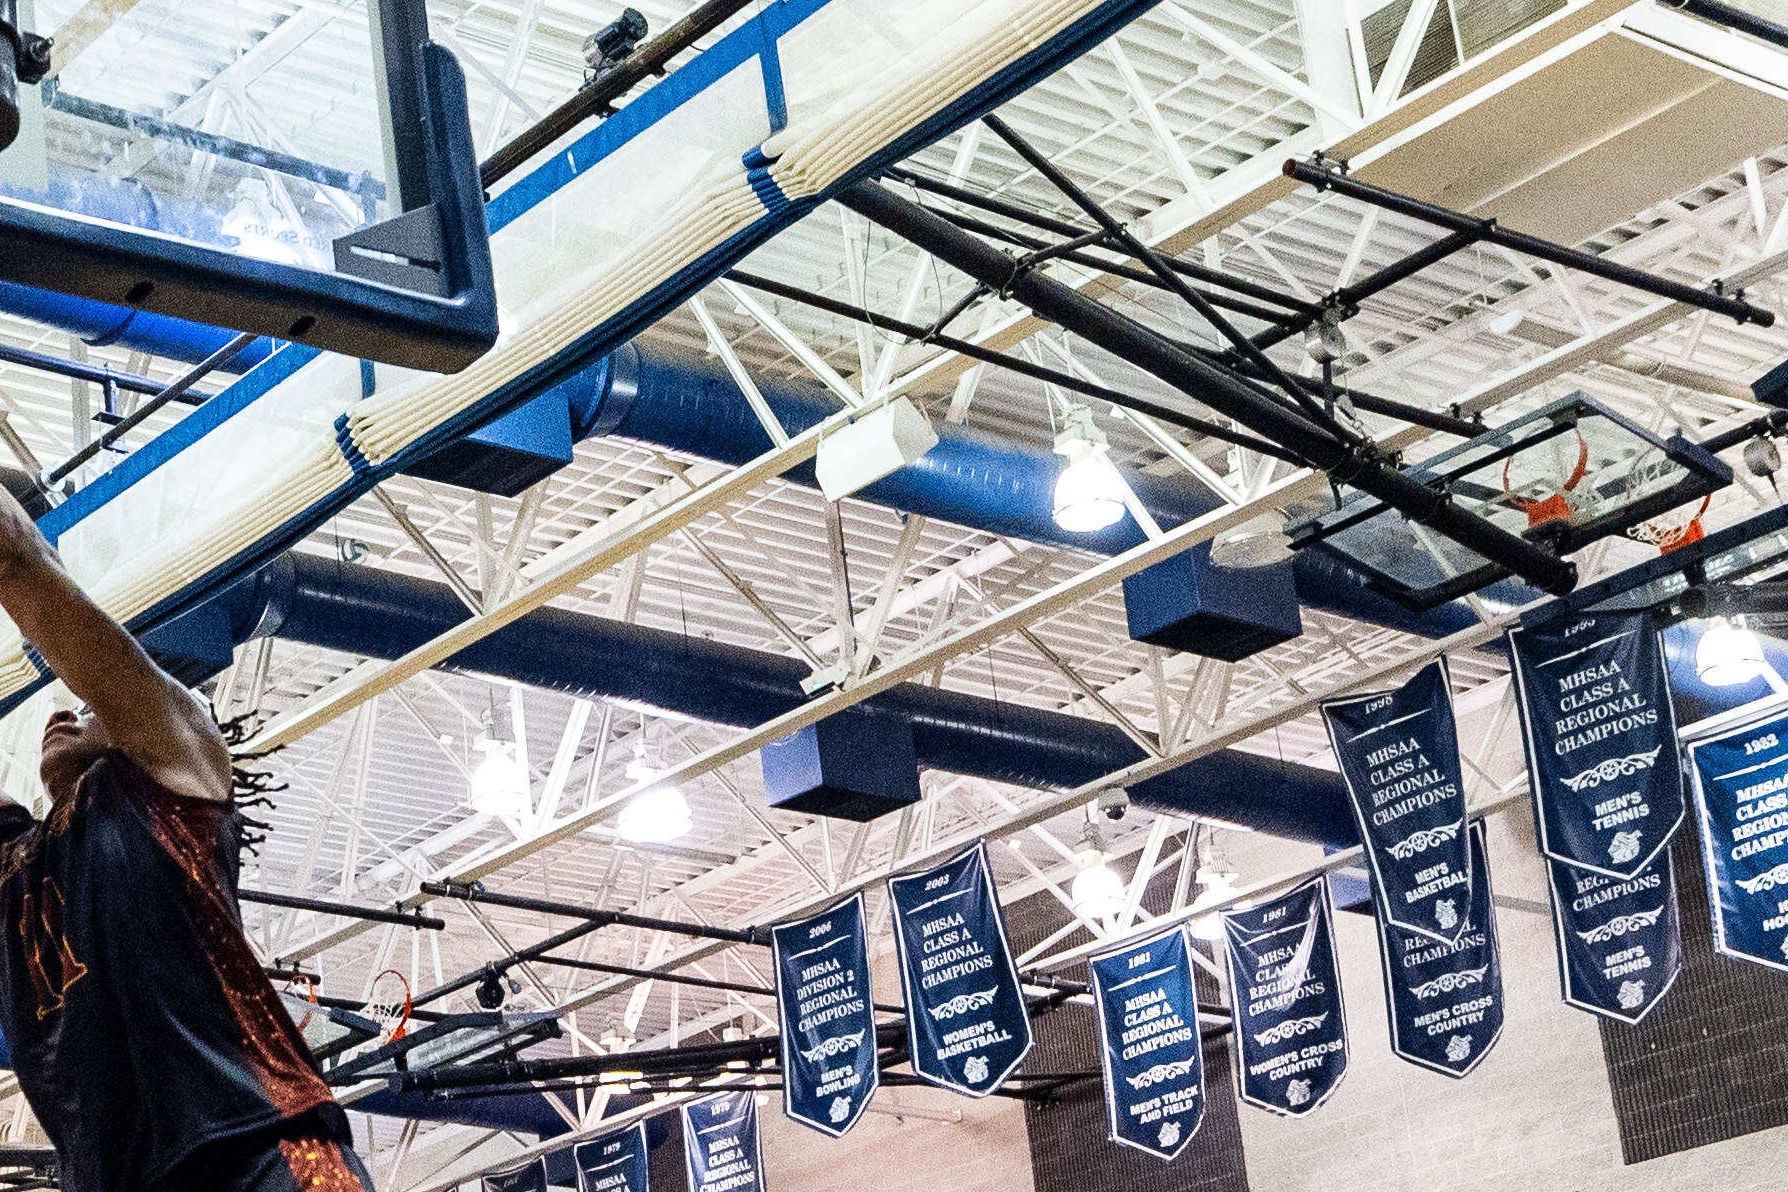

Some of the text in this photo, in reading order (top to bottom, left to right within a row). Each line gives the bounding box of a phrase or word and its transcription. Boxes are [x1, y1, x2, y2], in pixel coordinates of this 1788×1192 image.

[1559, 660, 1622, 692] MHSAA
[1561, 678, 1630, 713] CLASS A
[1555, 693, 1646, 735] REGIONAL
[1555, 709, 1658, 756] CHAMPIONS
[1744, 734, 1779, 754] 1982
[1366, 737, 1420, 768] MHSAA
[1371, 754, 1430, 786] CLASS A
[1372, 769, 1446, 807] REGIONAL
[1373, 784, 1457, 826] CHAMPIONS
[1592, 803, 1650, 831] TENNIS
[1595, 791, 1642, 817] MEN'S
[1736, 793, 1788, 821] CLASS
[1405, 869, 1468, 904] BASKETBAL
[1415, 862, 1449, 884] MEN'S
[1573, 874, 1660, 912] CHAMPIONS
[922, 913, 965, 937] MHSAA
[924, 928, 972, 954] CLASS A
[1606, 946, 1645, 966] MEN'S
[802, 958, 841, 982] MHSAA
[921, 941, 984, 972] REGIONAL
[1603, 956, 1651, 979] TENNIS
[796, 970, 854, 1000] DIVISION 2
[922, 955, 993, 989] CHAMPIONS
[799, 986, 857, 1016] REGIONAL
[1124, 1002, 1173, 1027] CLASS A
[1125, 988, 1166, 1012] MHSAA
[1249, 982, 1325, 1017] CHAMPIONS
[1414, 996, 1493, 1027] MEN'S CROSS
[798, 1000, 864, 1032] CHAMPIONS
[1122, 1015, 1184, 1045] REGIONAL
[1427, 1010, 1484, 1036] COUNTRY
[937, 1030, 1012, 1060] BASKETBALL
[943, 1021, 996, 1045] WOMEN'S
[1123, 1028, 1192, 1060] CHAMPIONS
[1250, 1039, 1343, 1075] WOMEN'S CROSS
[1269, 1056, 1324, 1081] COUNTRY
[816, 1074, 861, 1097] BOWLING
[821, 1065, 853, 1083] MEN'S
[1130, 1085, 1198, 1115] MEN'S TRACK
[1140, 1100, 1193, 1124] AND FIELD
[703, 1159, 751, 1183] REGIONAL
[709, 1148, 743, 1167] CLASS A
